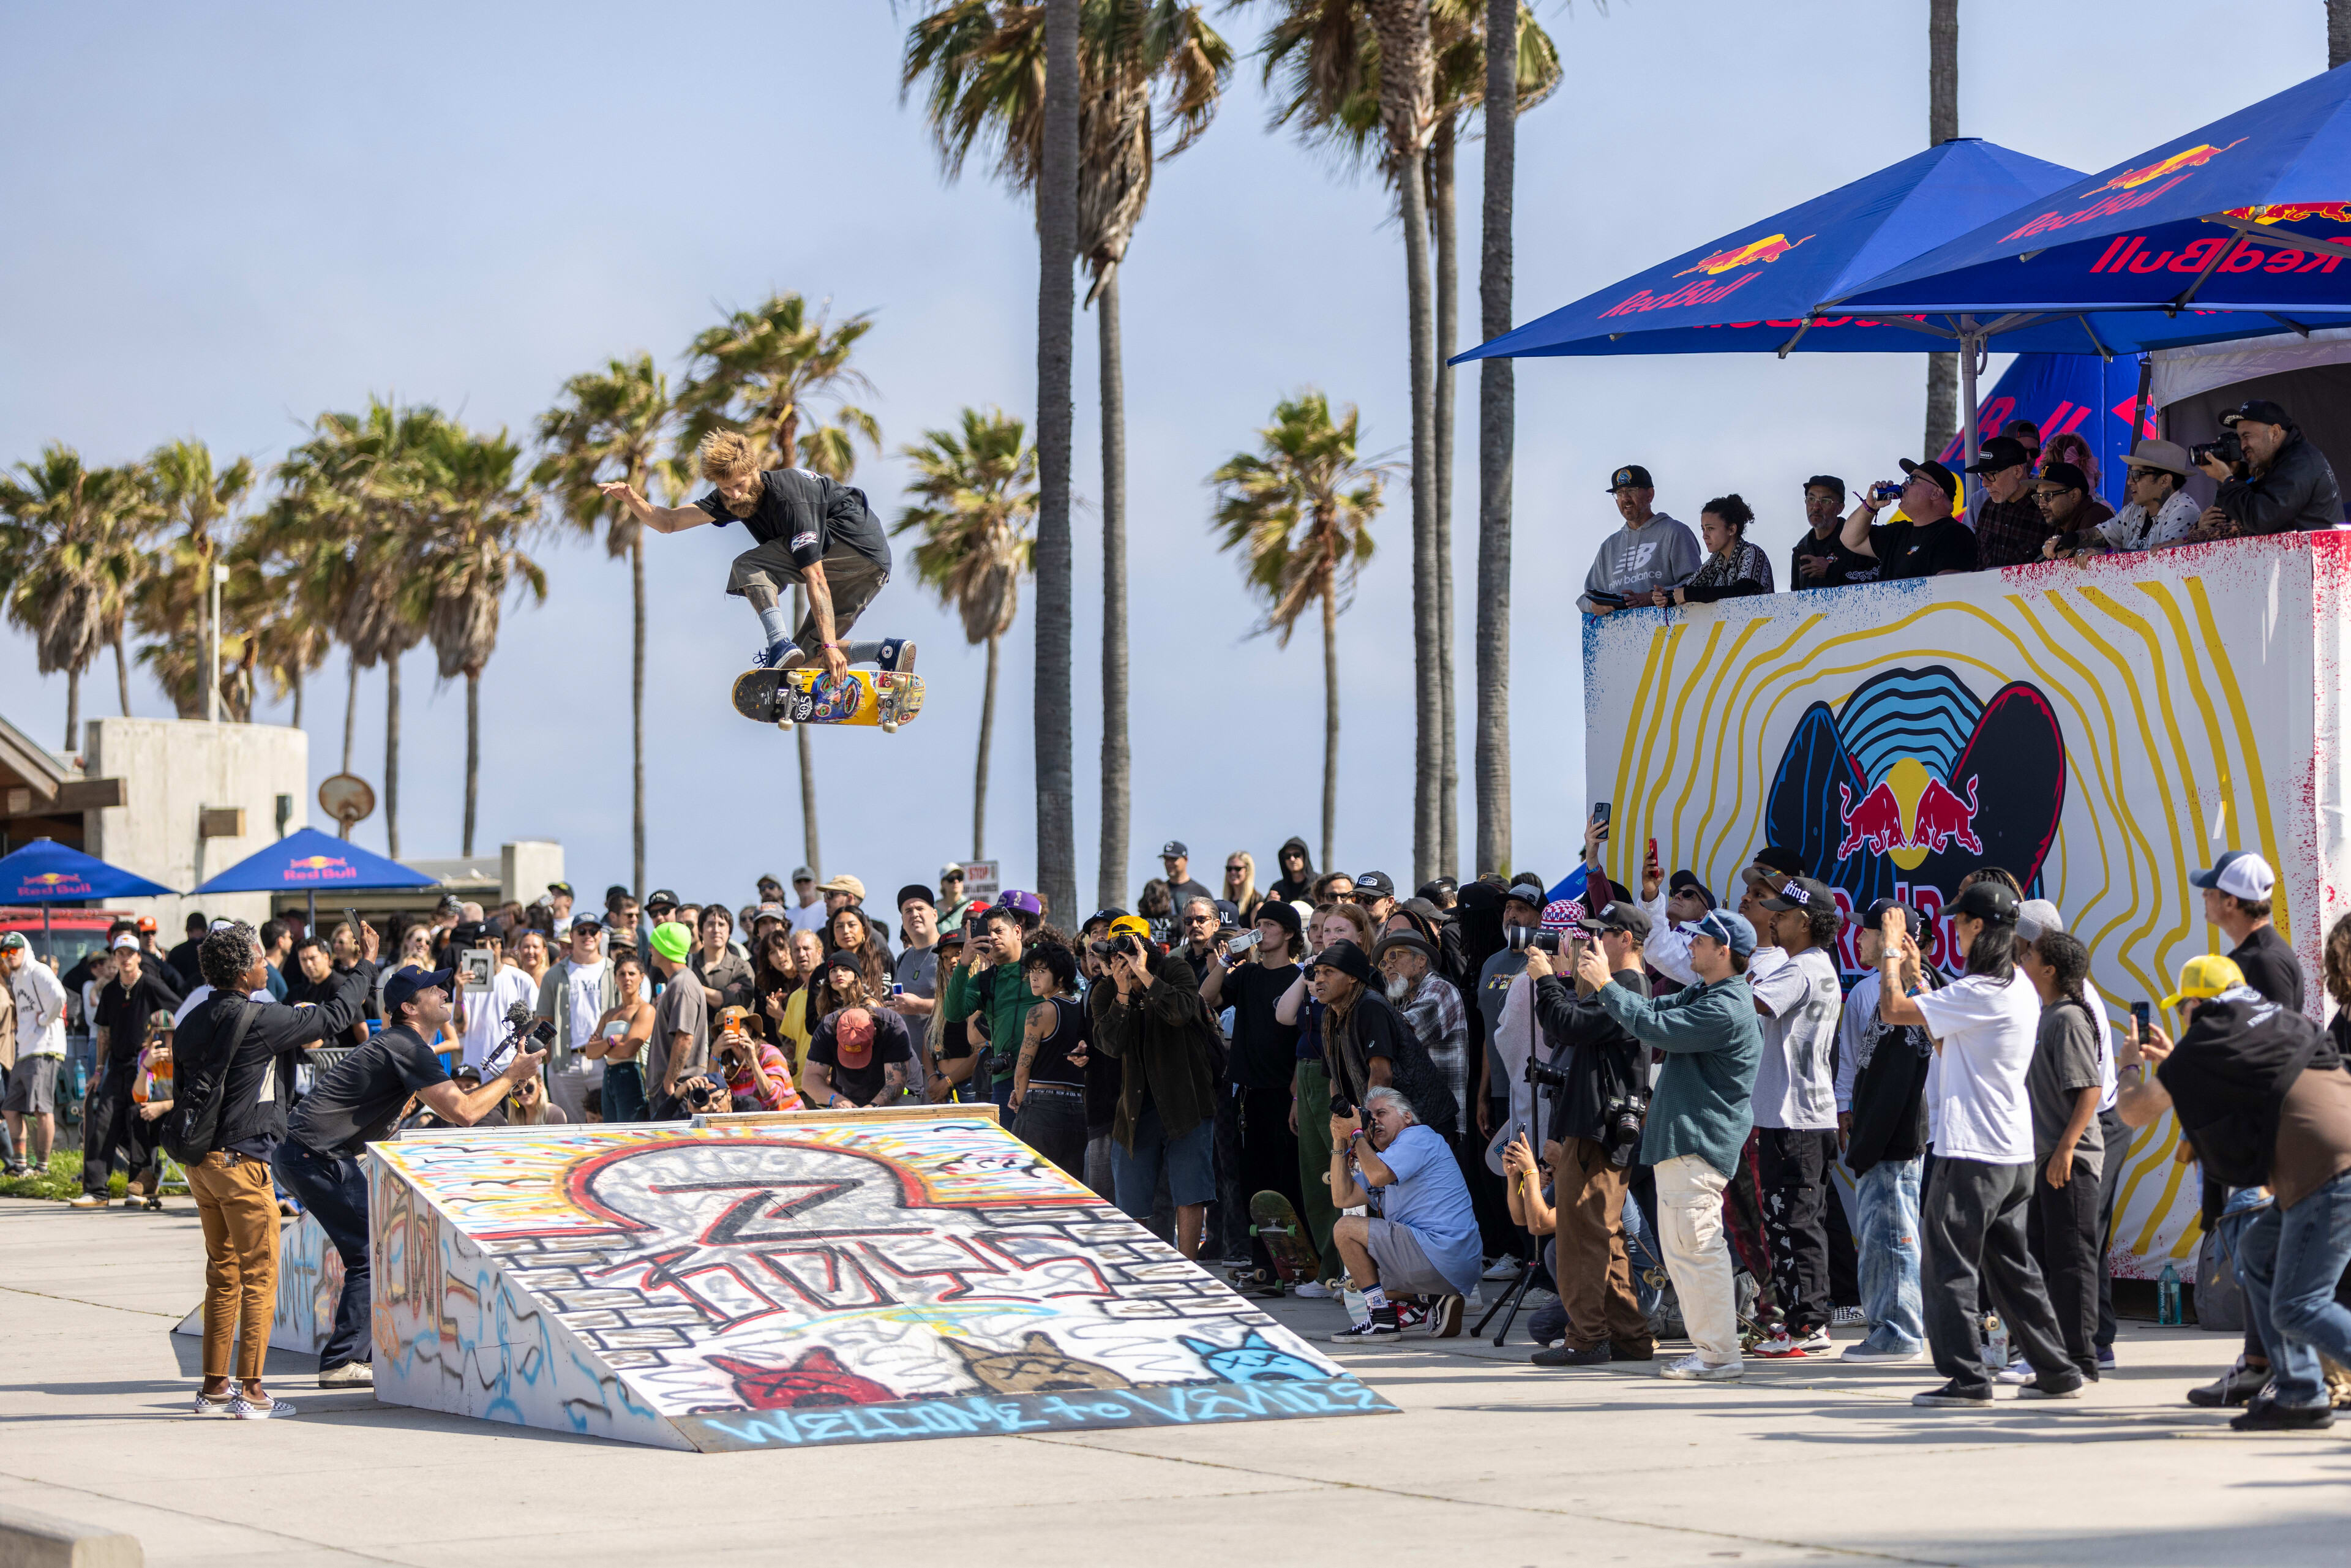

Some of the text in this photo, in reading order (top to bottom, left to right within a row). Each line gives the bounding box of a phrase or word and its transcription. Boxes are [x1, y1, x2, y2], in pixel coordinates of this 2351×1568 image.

[1624, 571, 1662, 585] balance
[796, 695, 811, 721] 805
[283, 866, 357, 880] Red Bull
[969, 866, 988, 880] STOP
[17, 882, 91, 896] Red Bull
